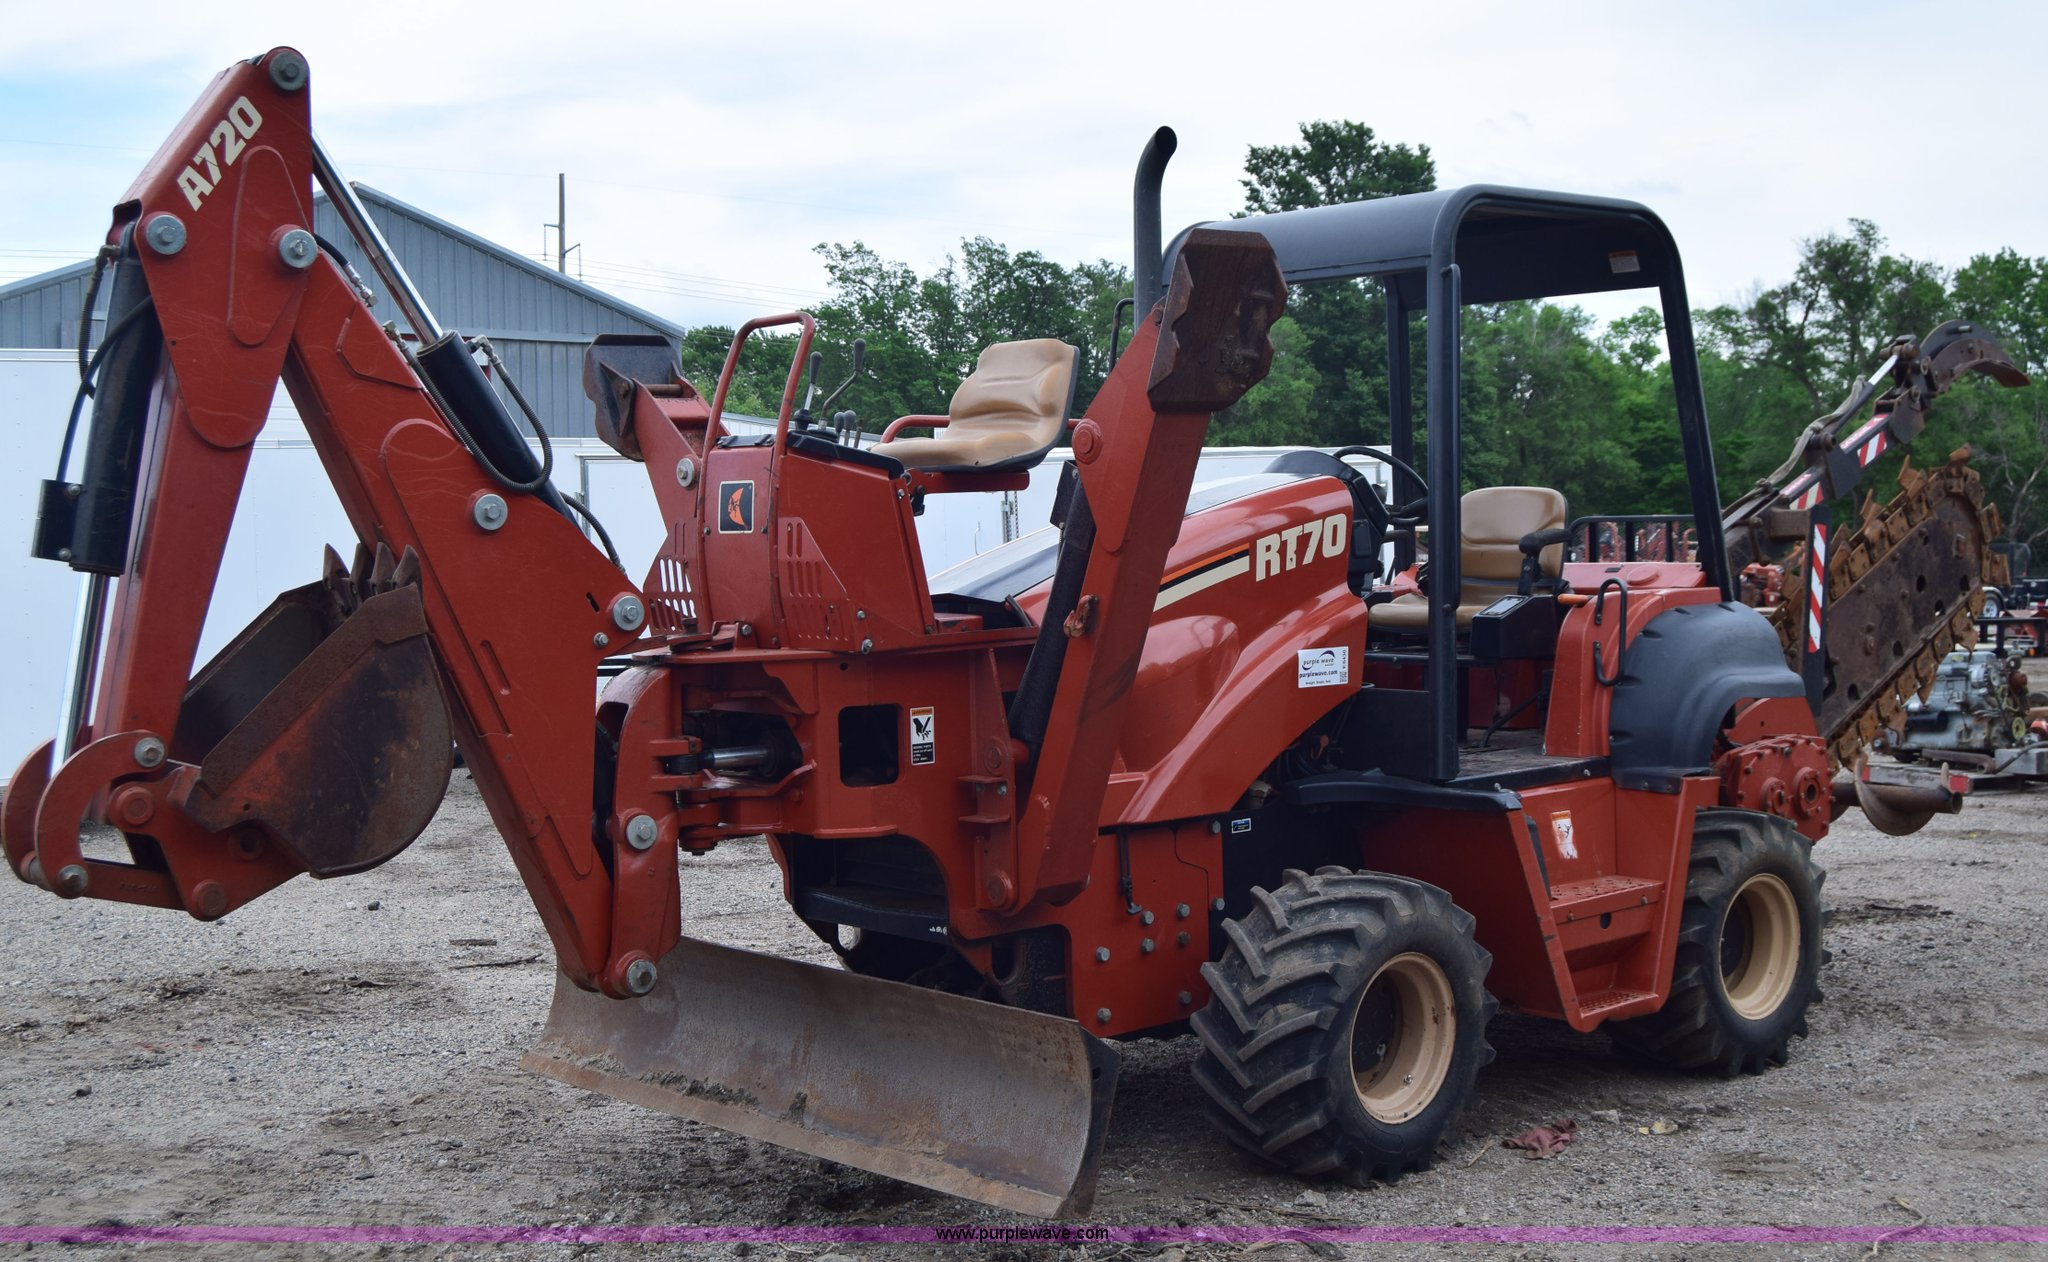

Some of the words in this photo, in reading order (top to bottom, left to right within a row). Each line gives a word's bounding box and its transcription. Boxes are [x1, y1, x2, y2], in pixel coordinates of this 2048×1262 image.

[177, 95, 263, 212] A720
[1255, 513, 1347, 582] RT70
[1299, 670, 1338, 679] purplewave.com
